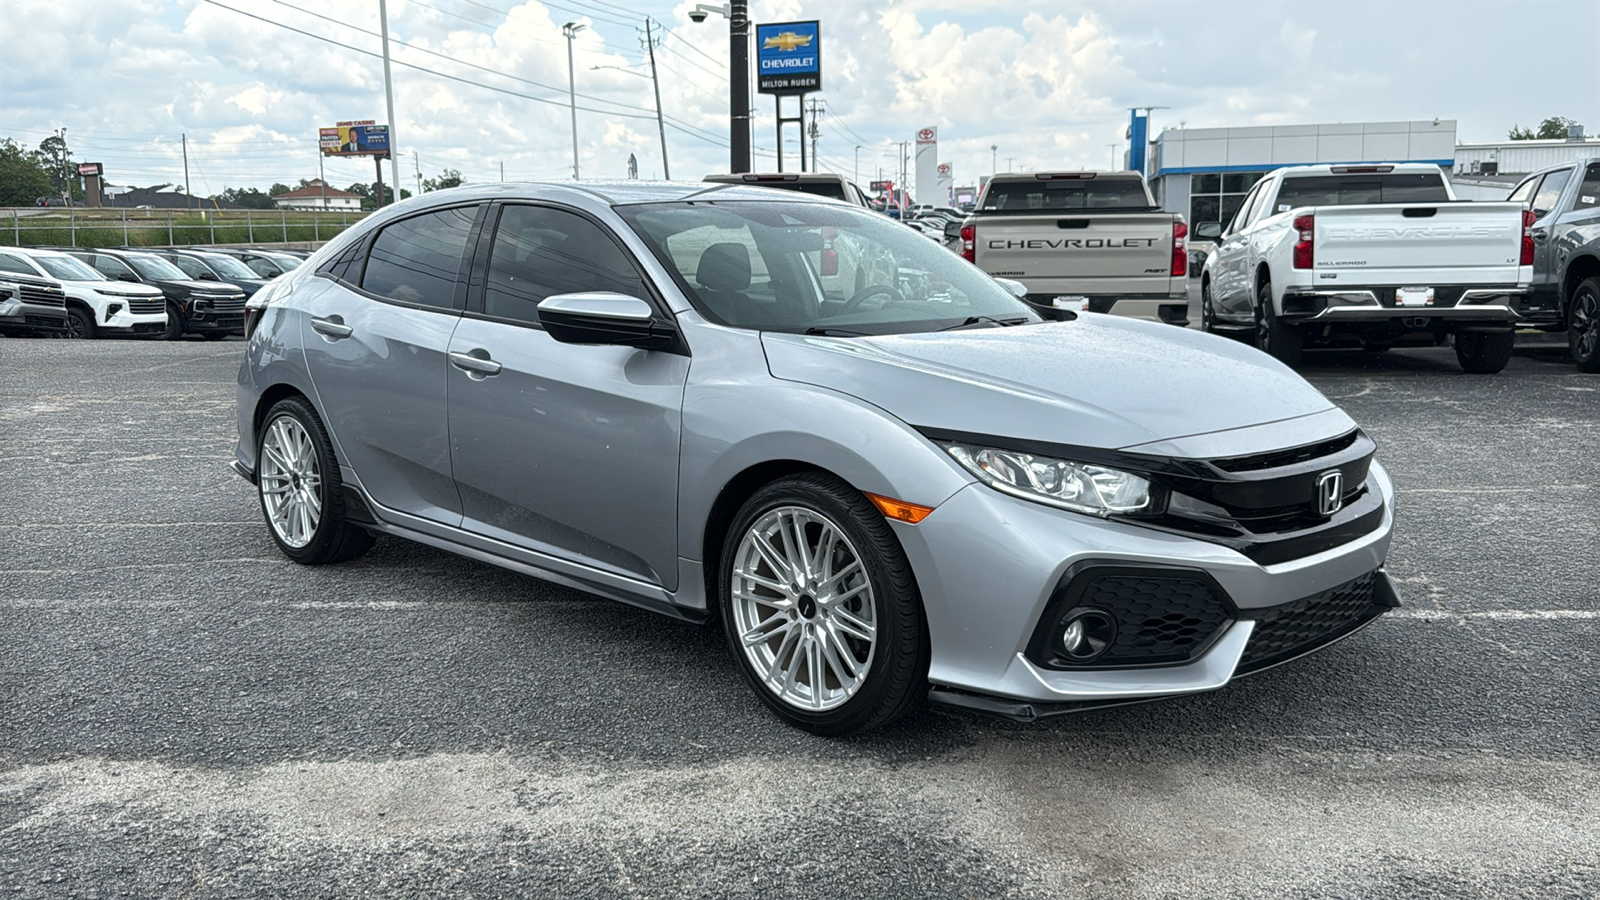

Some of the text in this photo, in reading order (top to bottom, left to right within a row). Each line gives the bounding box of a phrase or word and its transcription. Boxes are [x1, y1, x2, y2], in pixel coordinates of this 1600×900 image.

[762, 57, 814, 69] CHEVROLET
[762, 78, 816, 88] MILTON RUBEN
[1328, 226, 1509, 241] CHEVROLET
[988, 238, 1159, 250] CHEVROLET
